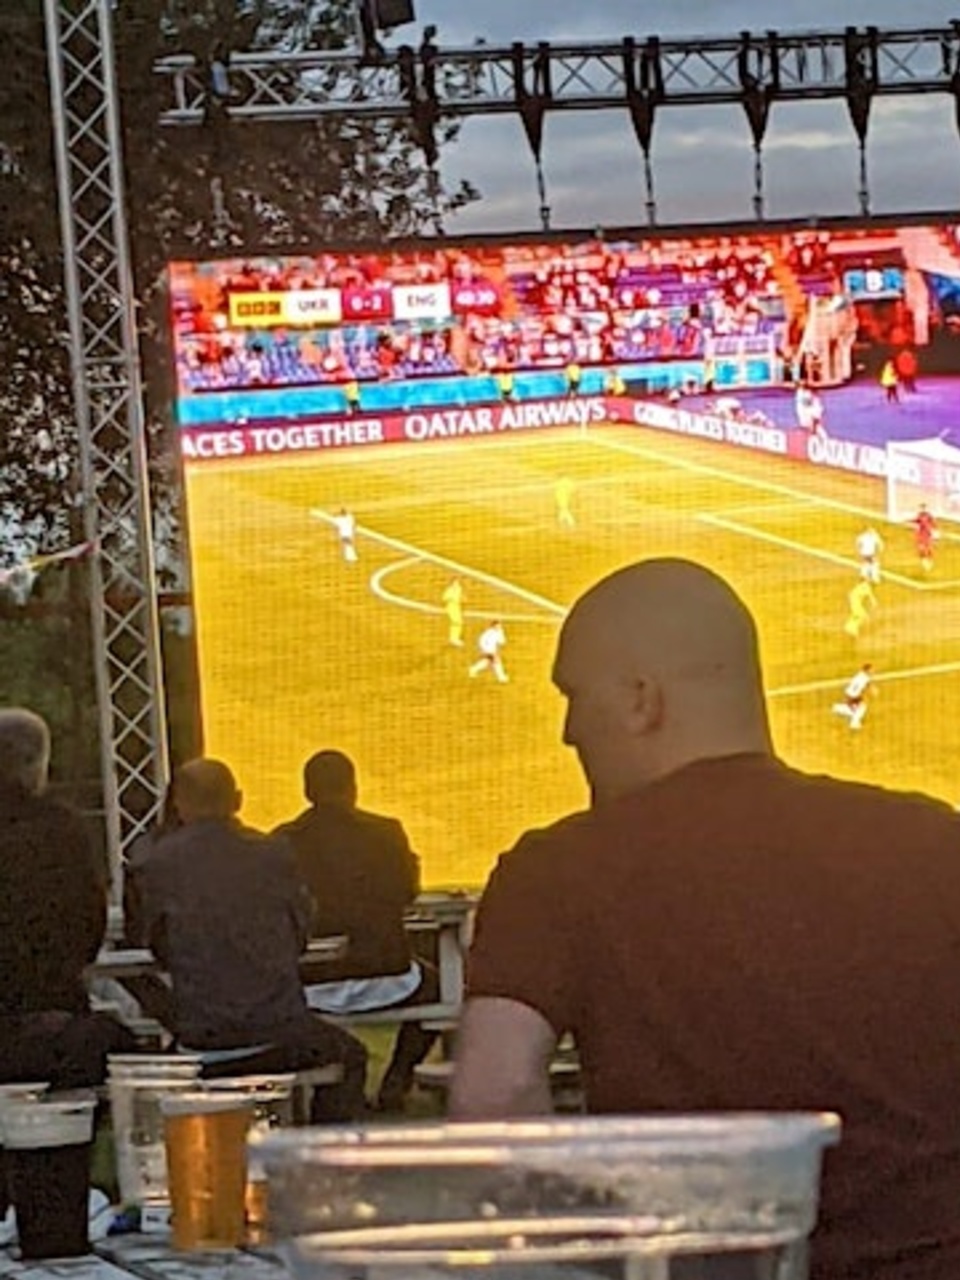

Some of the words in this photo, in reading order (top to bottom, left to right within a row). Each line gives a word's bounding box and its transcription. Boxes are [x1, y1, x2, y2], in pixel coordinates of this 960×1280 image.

[298, 298, 329, 313] UKR
[407, 293, 437, 308] ENG
[404, 408, 494, 440] QATAR
[498, 398, 606, 430] AIRWAYS
[250, 420, 384, 452] TOGETHER
